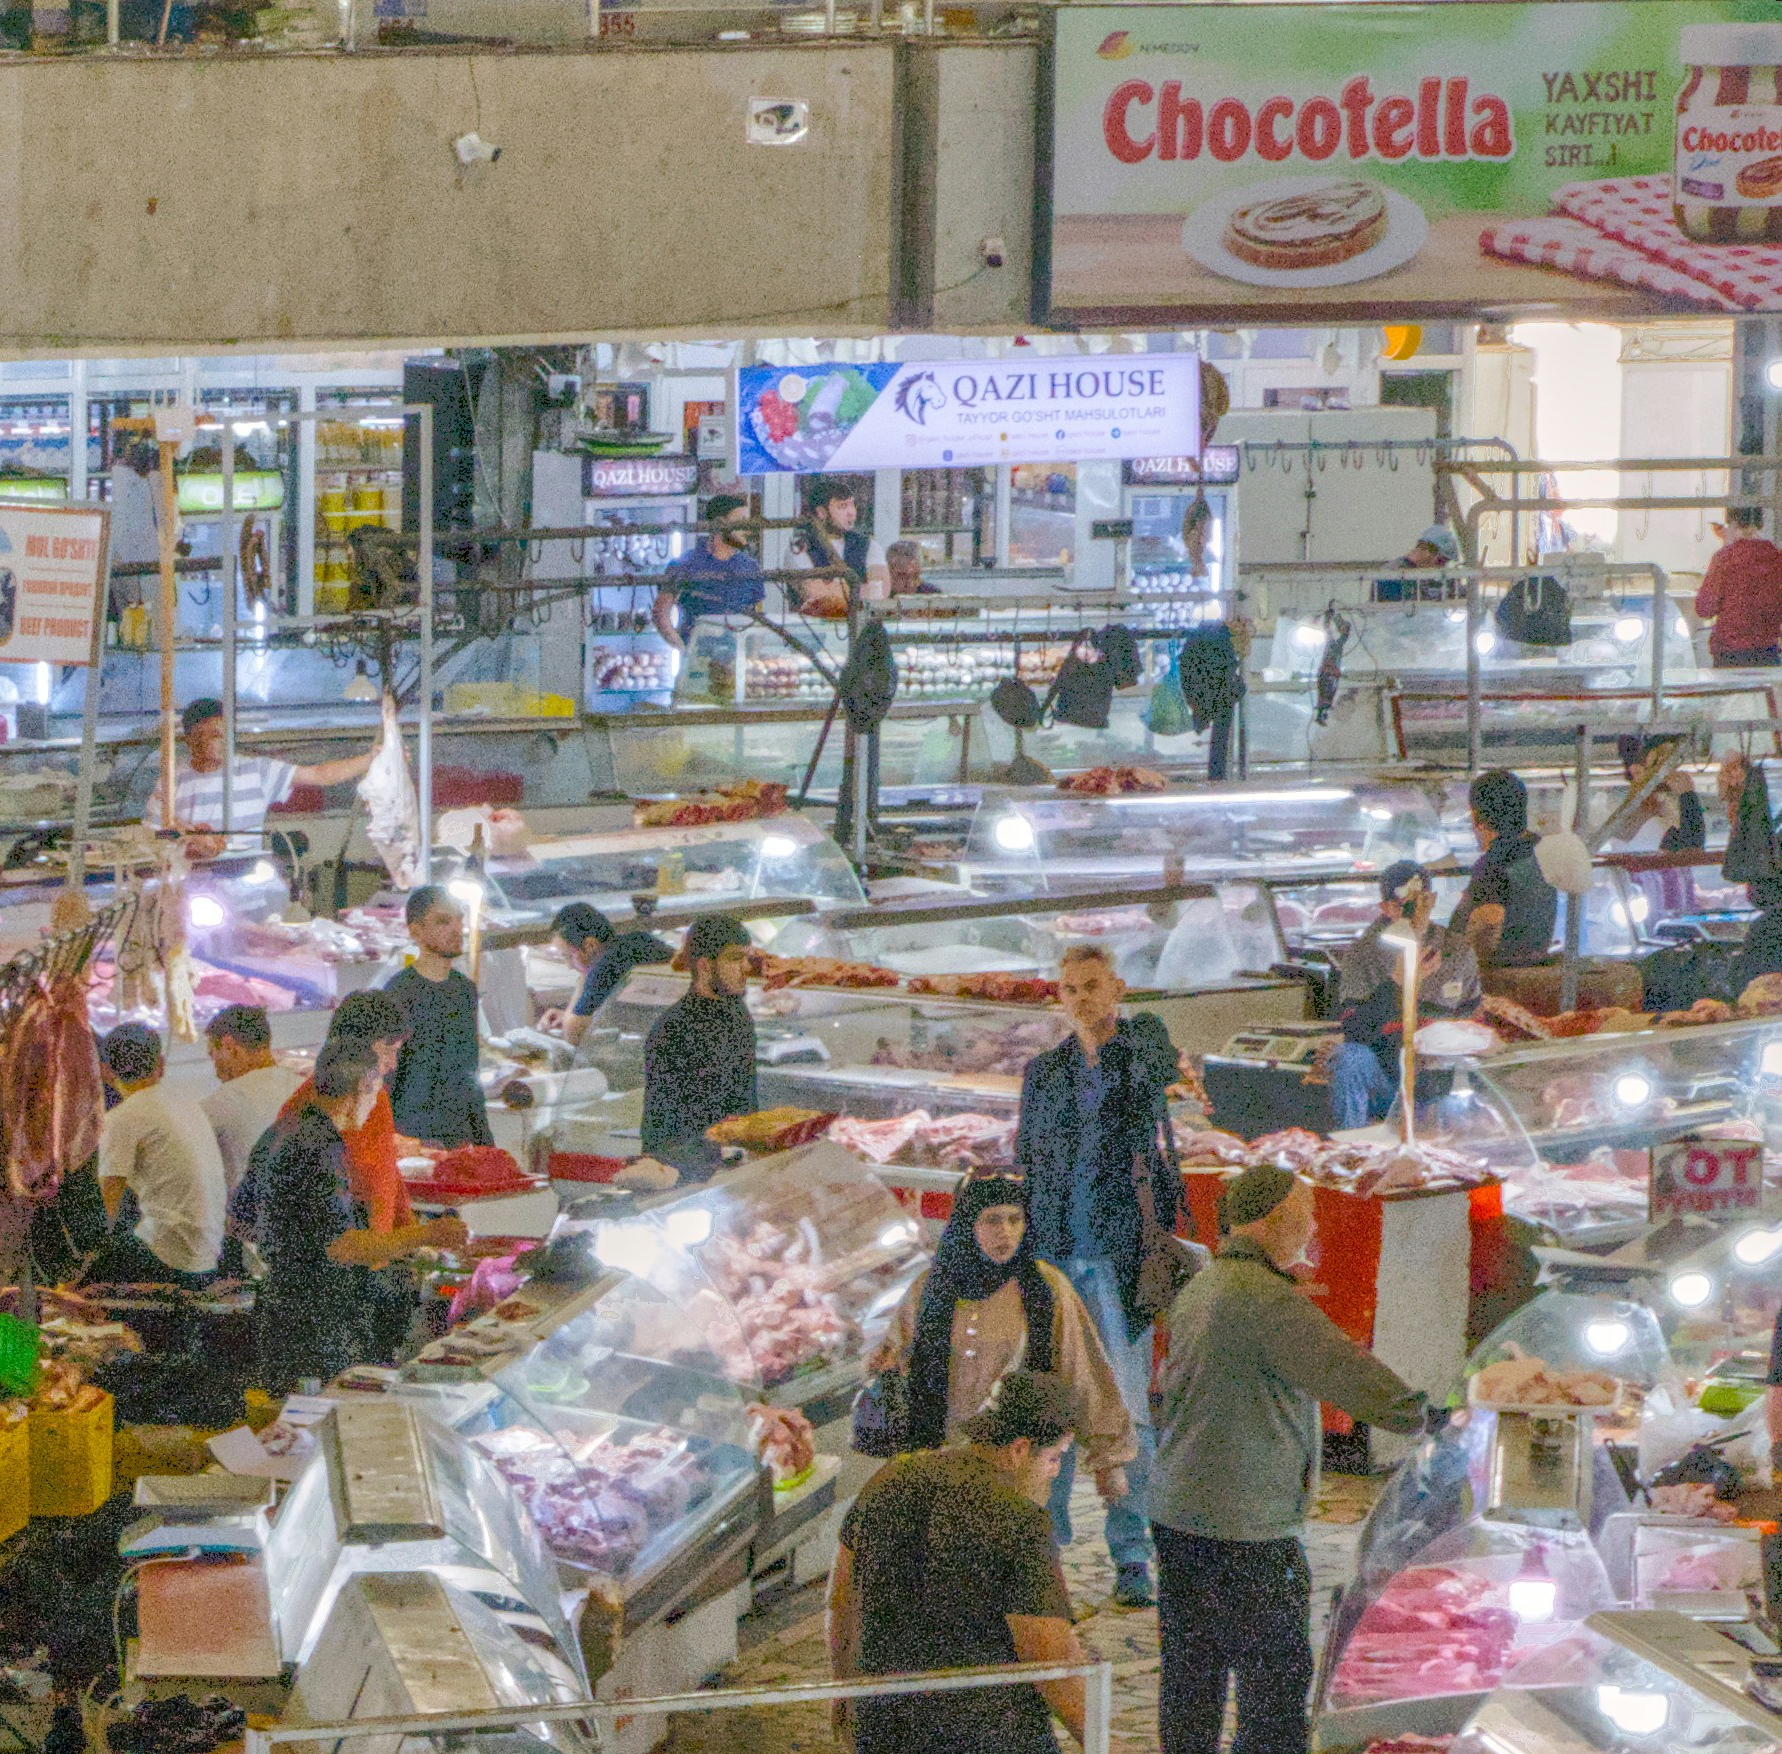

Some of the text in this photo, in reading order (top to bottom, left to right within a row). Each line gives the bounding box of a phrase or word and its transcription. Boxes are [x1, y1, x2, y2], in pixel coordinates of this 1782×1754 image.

[1541, 70, 1658, 103] YAXSHI
[1101, 75, 1514, 165] Chocotella
[1544, 112, 1655, 136] KAYFIYAT
[952, 369, 1166, 406] QAZI HOUSE
[956, 407, 1166, 424] TAYYOR GO'SHT MAHSULOTLARI
[593, 465, 695, 488] QAZI HOUSE
[1132, 455, 1236, 474] QAZI HUSE
